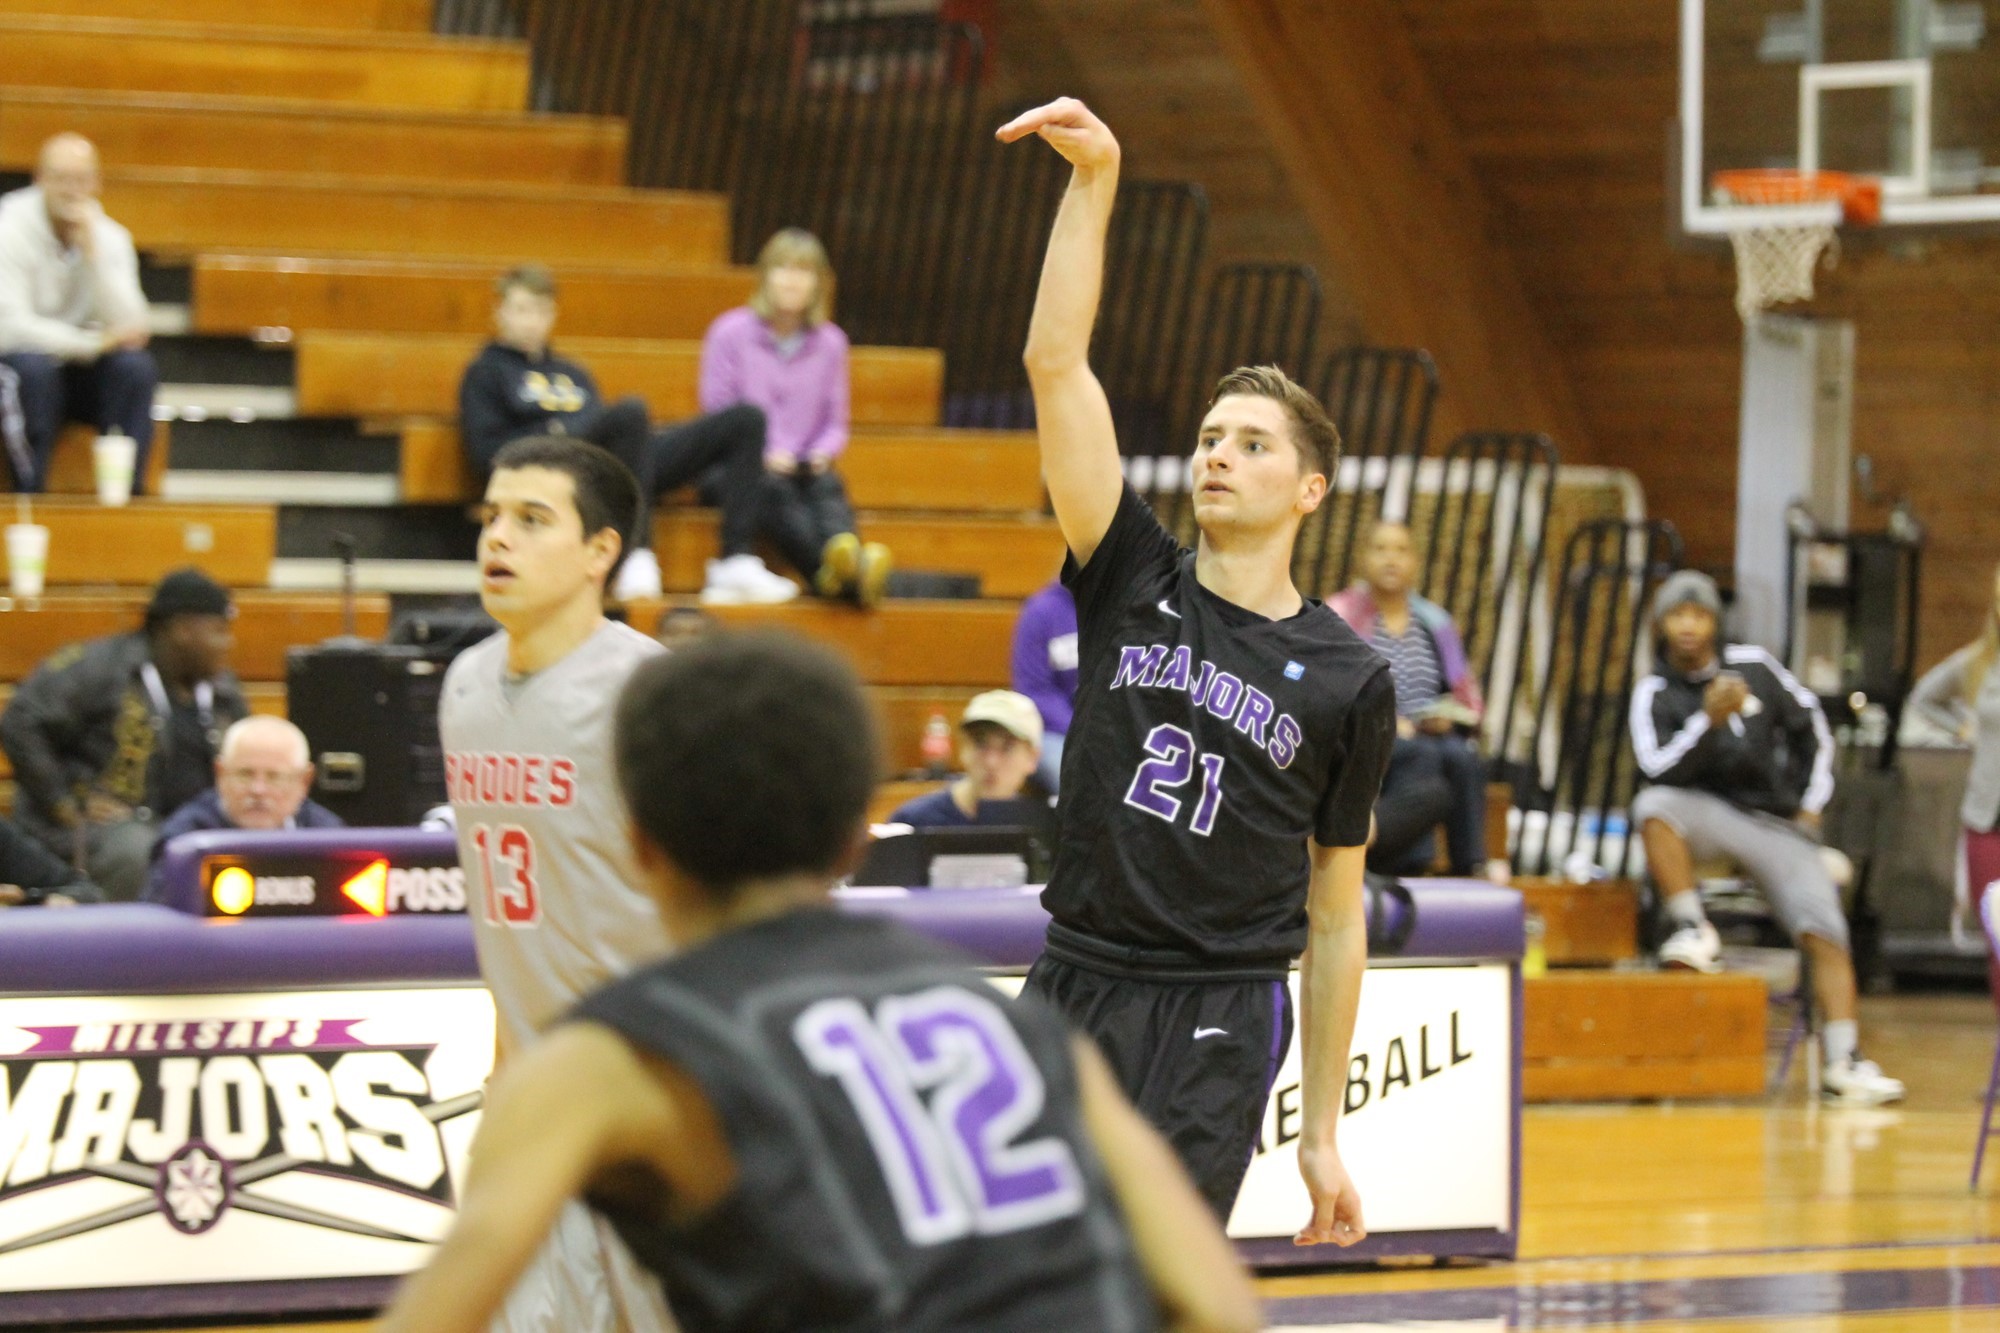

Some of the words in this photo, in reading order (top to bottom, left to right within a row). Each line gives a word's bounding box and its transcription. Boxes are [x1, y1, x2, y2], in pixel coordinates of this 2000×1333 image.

[1109, 644, 1302, 770] MAJORS
[1123, 722, 1225, 837] 21
[469, 822, 543, 929] 13
[70, 1021, 325, 1053] MILLSAPS
[793, 984, 1086, 1246] 12
